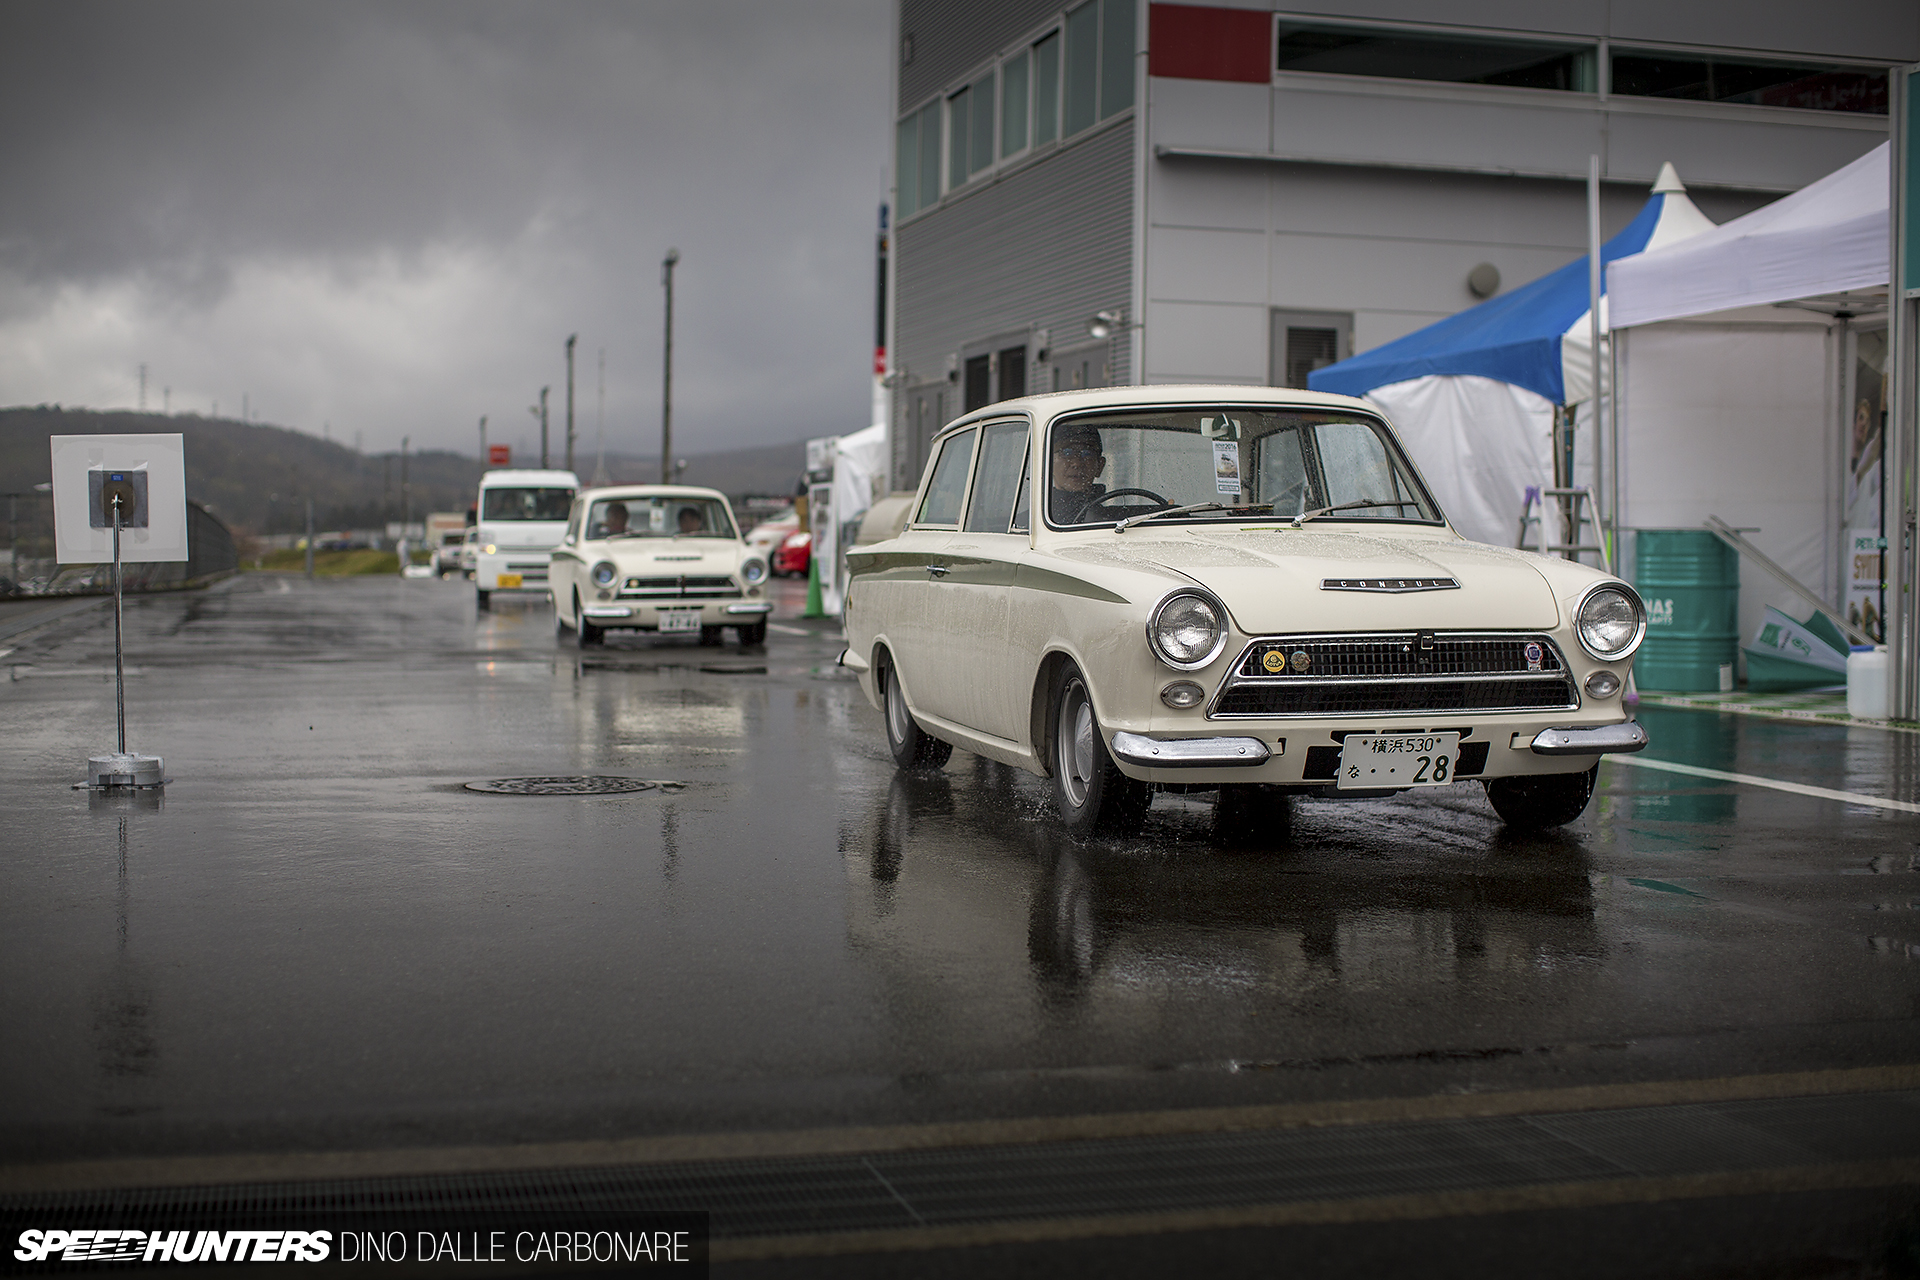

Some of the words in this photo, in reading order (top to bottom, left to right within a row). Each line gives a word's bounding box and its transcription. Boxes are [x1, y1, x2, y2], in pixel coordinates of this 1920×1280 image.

[1340, 579, 1440, 588] CONSUL
[1371, 738, 1435, 754] 横浜530
[1347, 764, 1360, 779] な
[1412, 755, 1450, 783] 28
